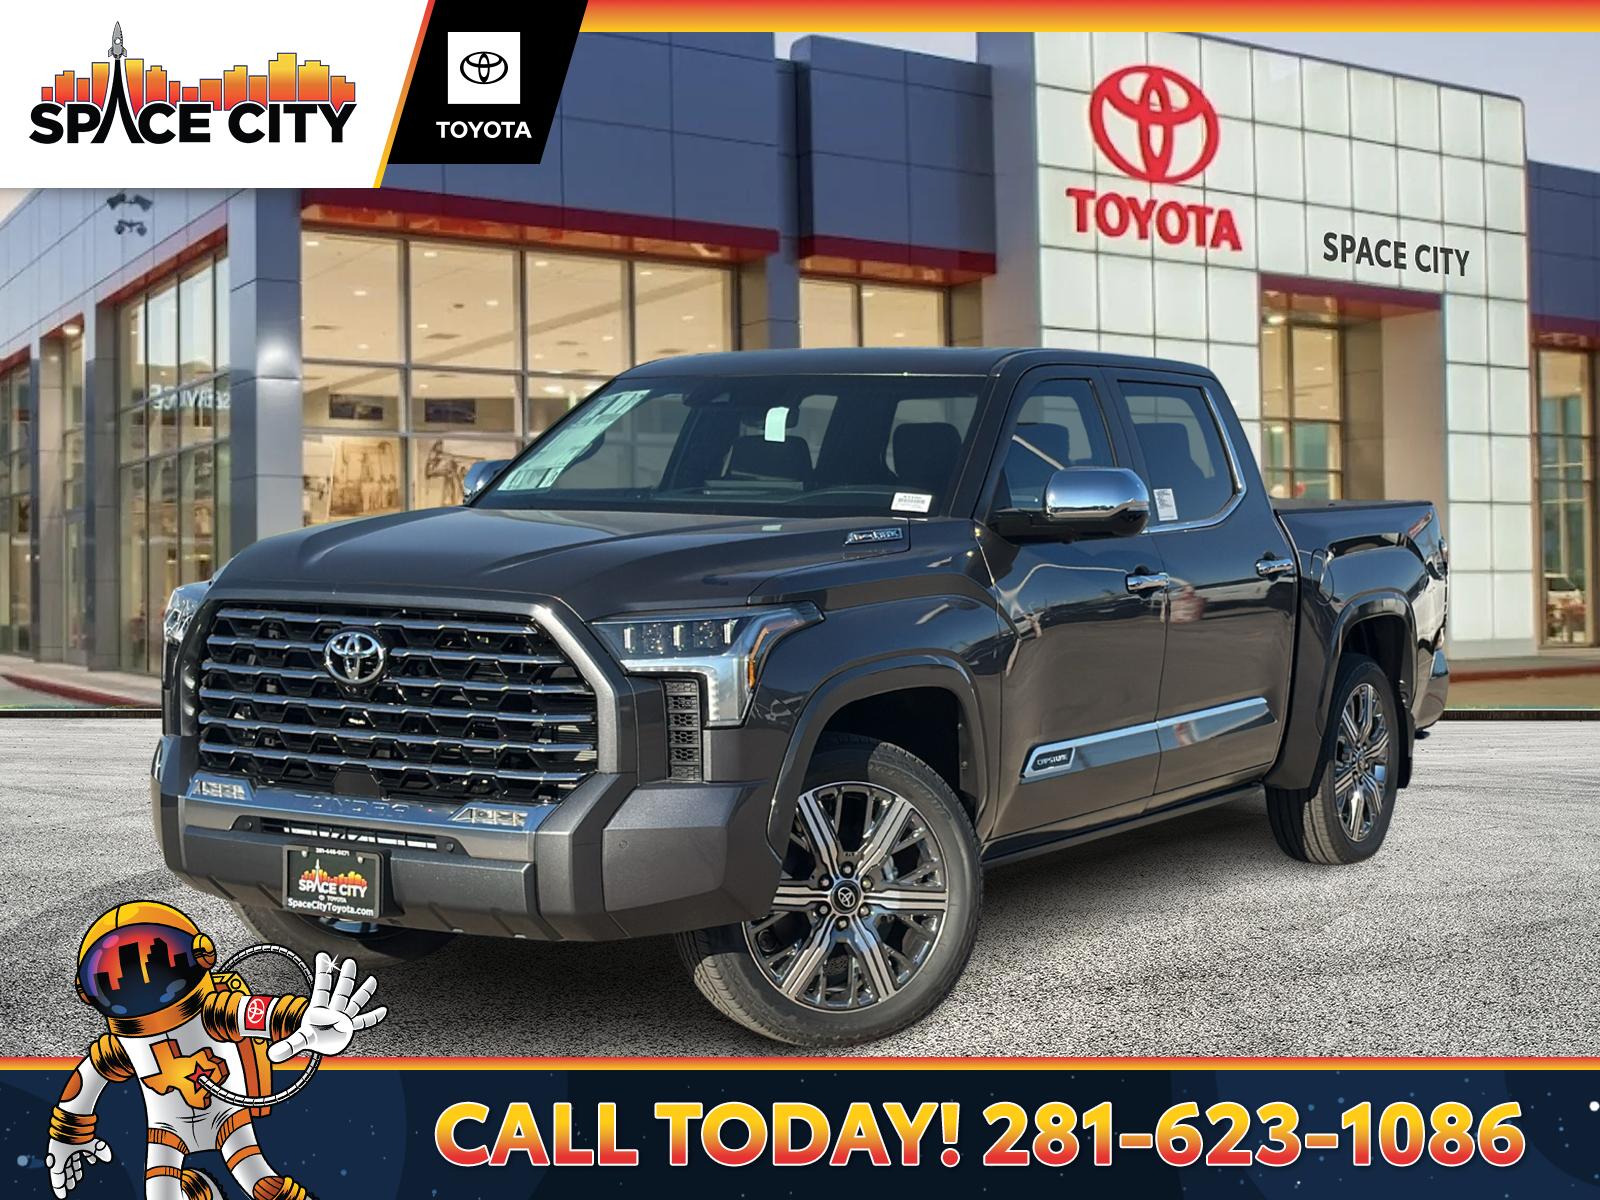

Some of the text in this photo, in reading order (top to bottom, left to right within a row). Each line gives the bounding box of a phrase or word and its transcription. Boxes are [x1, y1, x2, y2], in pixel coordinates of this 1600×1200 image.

[1066, 187, 1242, 251] TOYOTA
[1323, 232, 1470, 277] SPACE CITY
[298, 869, 368, 898] SPACE CITY
[287, 897, 374, 917] SpaceCityToyota.com
